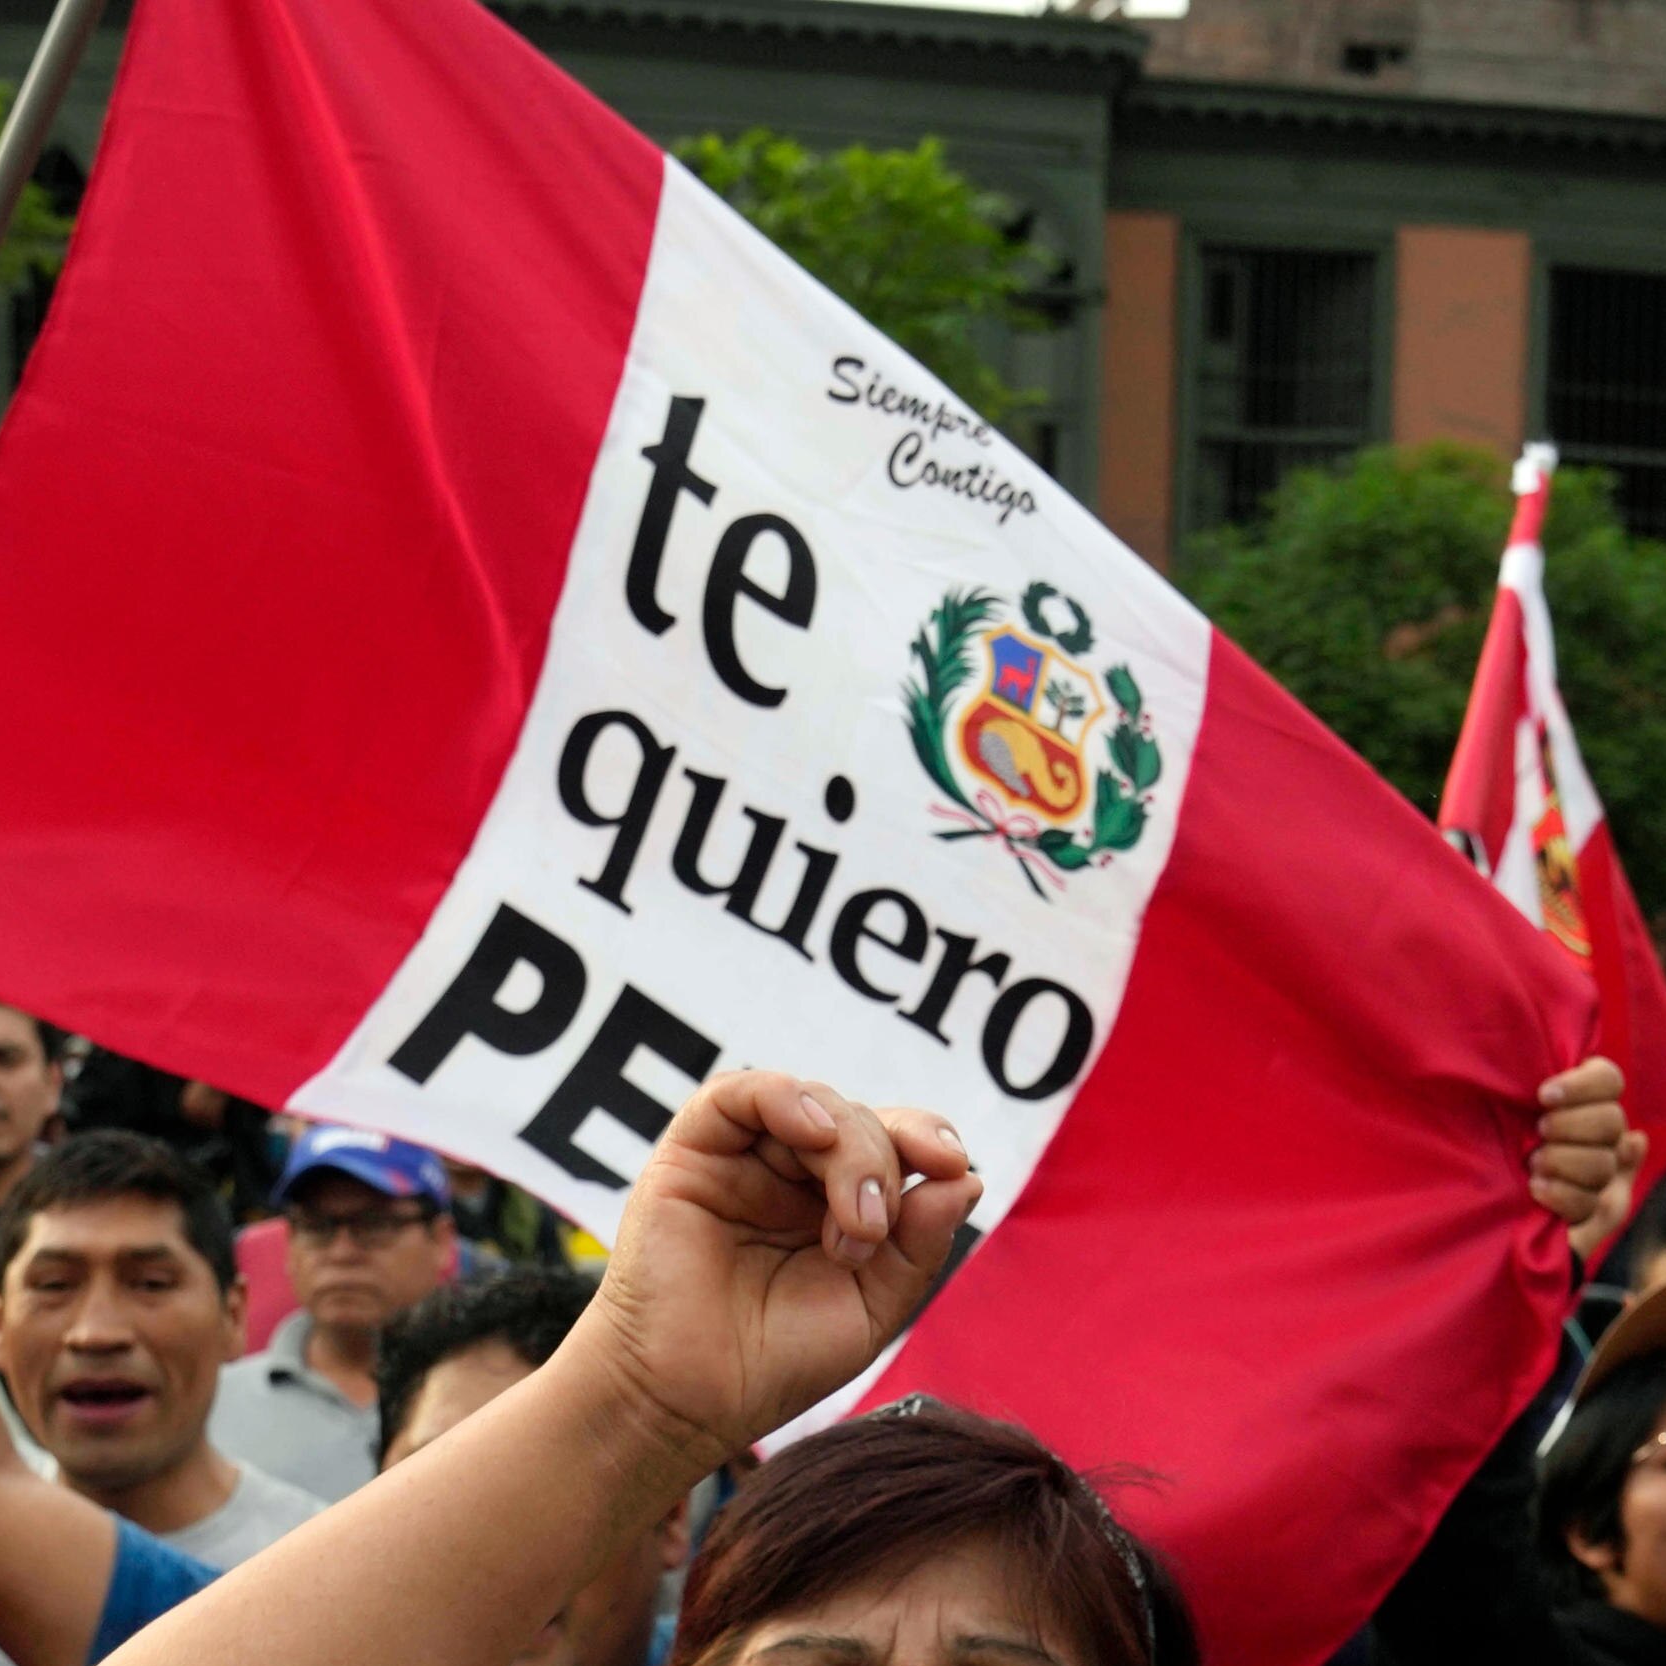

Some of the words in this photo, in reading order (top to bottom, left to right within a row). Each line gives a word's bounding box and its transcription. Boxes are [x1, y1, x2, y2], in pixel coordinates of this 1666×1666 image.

[827, 355, 994, 447] Siempre
[888, 431, 1038, 527] Contigo
[623, 395, 819, 709] te
[557, 707, 1095, 1104] quiero
